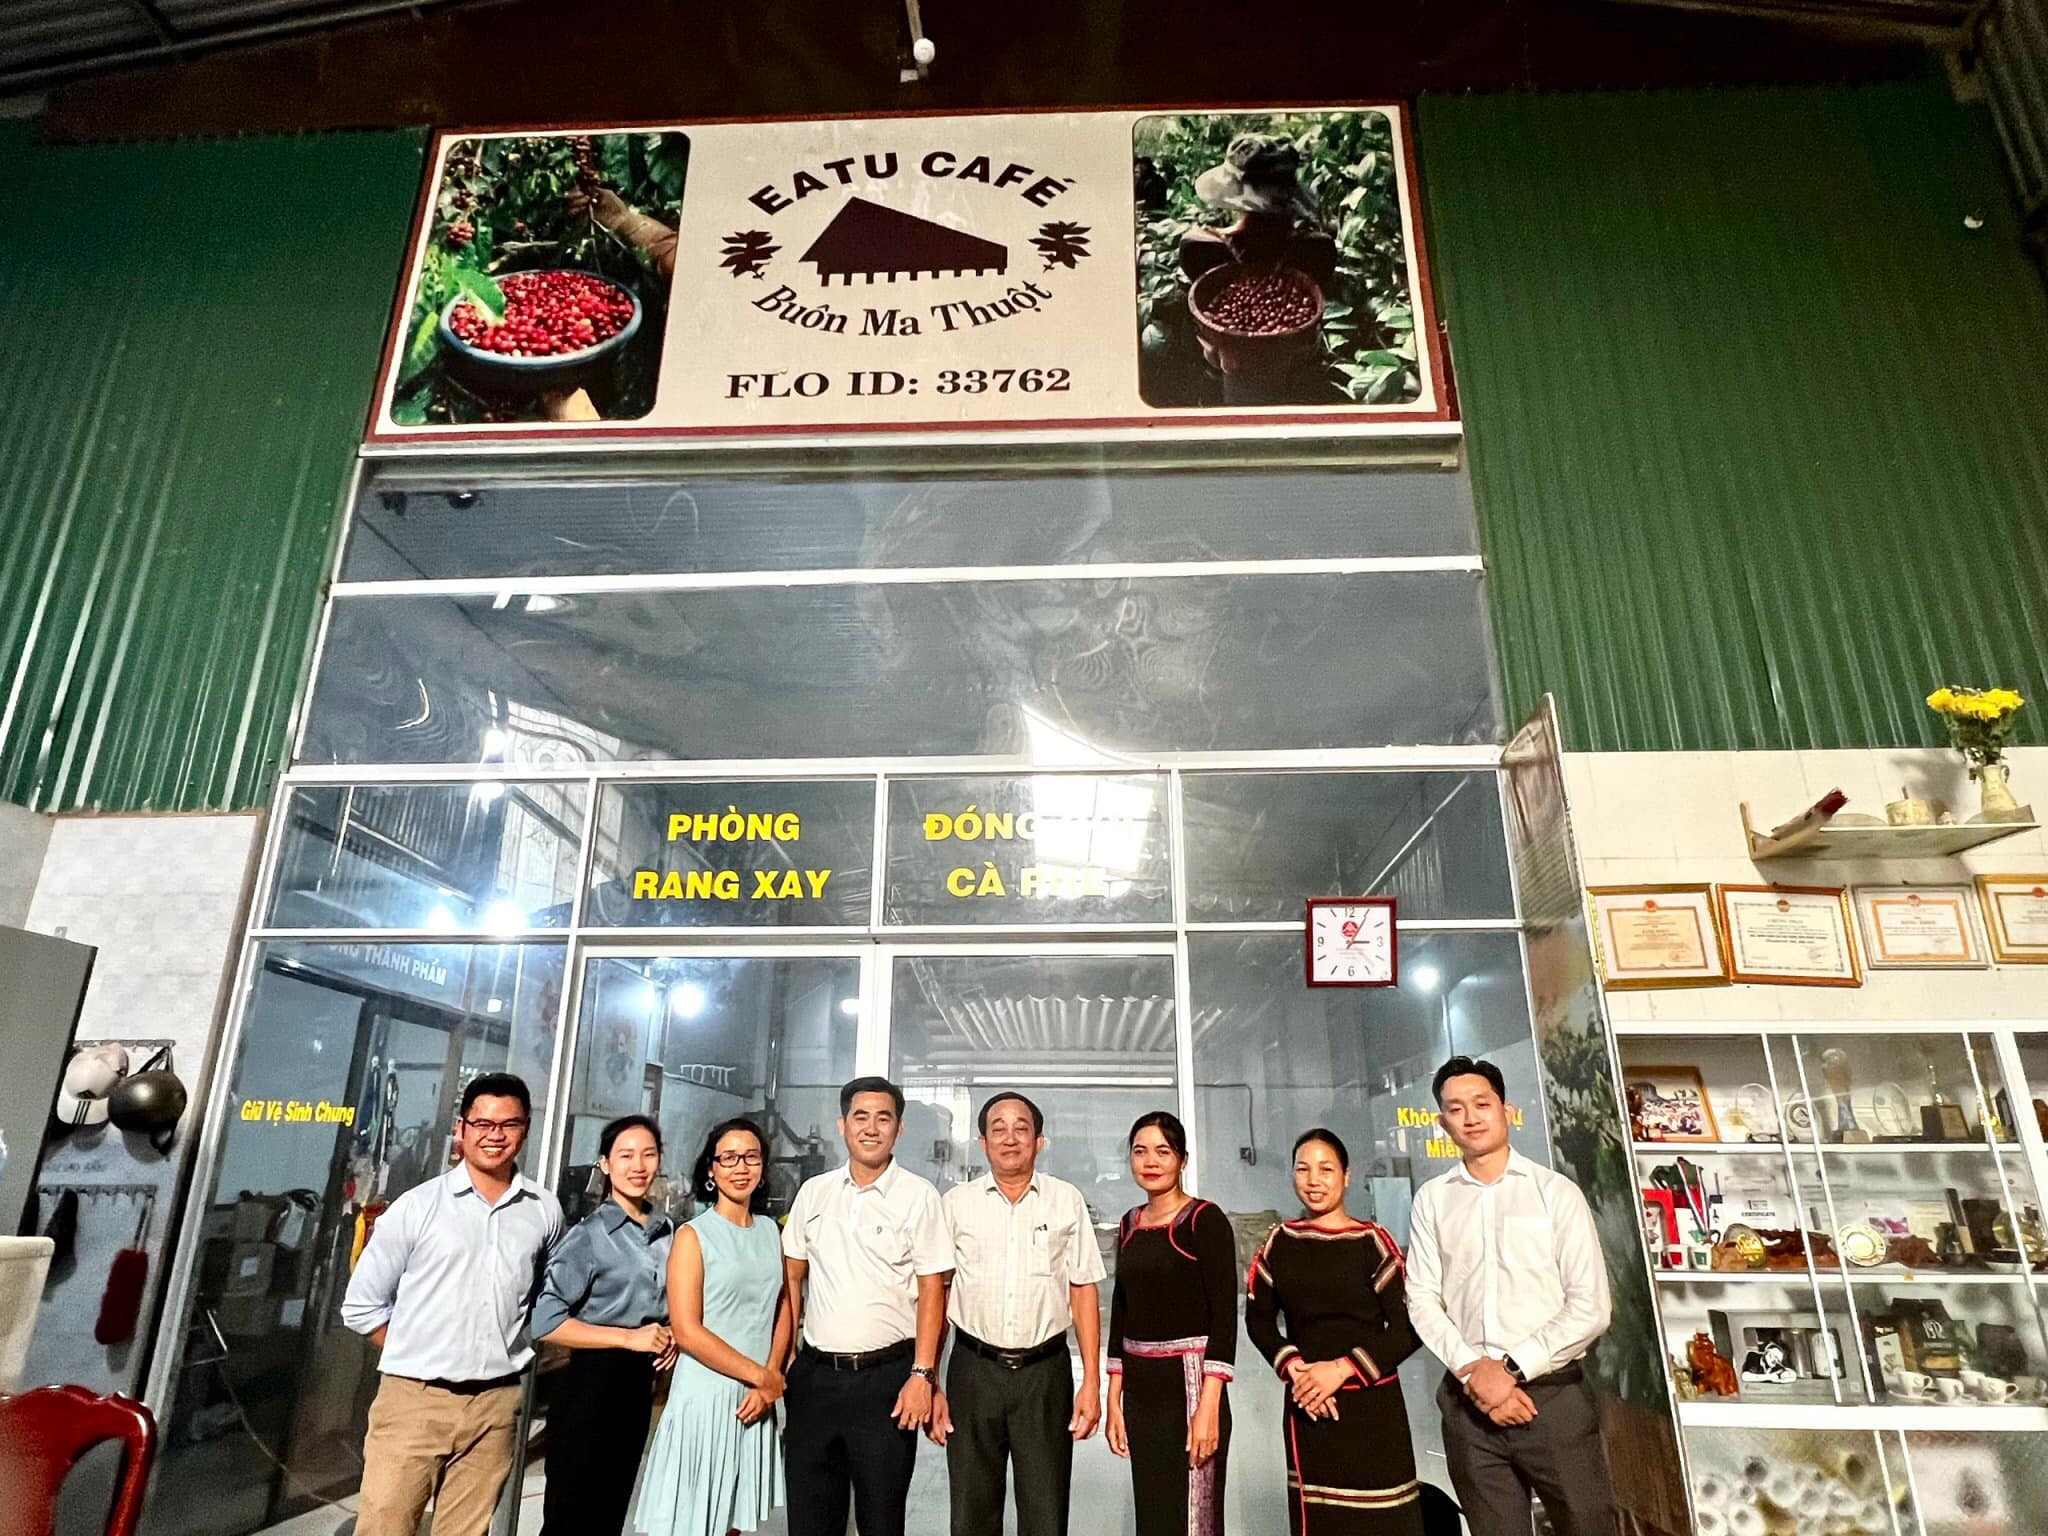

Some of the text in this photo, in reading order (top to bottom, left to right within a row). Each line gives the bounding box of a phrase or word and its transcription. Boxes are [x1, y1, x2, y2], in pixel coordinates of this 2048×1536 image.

[748, 151, 1077, 215] EATU CAFÉ
[751, 280, 1053, 336] Buôn Ma Thuột
[724, 368, 1071, 398] FLO ID: 33762
[667, 805, 800, 841] PHÒNG
[922, 804, 1036, 841] ĐÓNG
[633, 869, 832, 900] RANG XAY
[947, 861, 1006, 897] CÀ
[1348, 966, 1355, 977] 6
[266, 1100, 282, 1127] Vệ
[285, 1100, 312, 1122] Sinh
[315, 1100, 355, 1127] Chung
